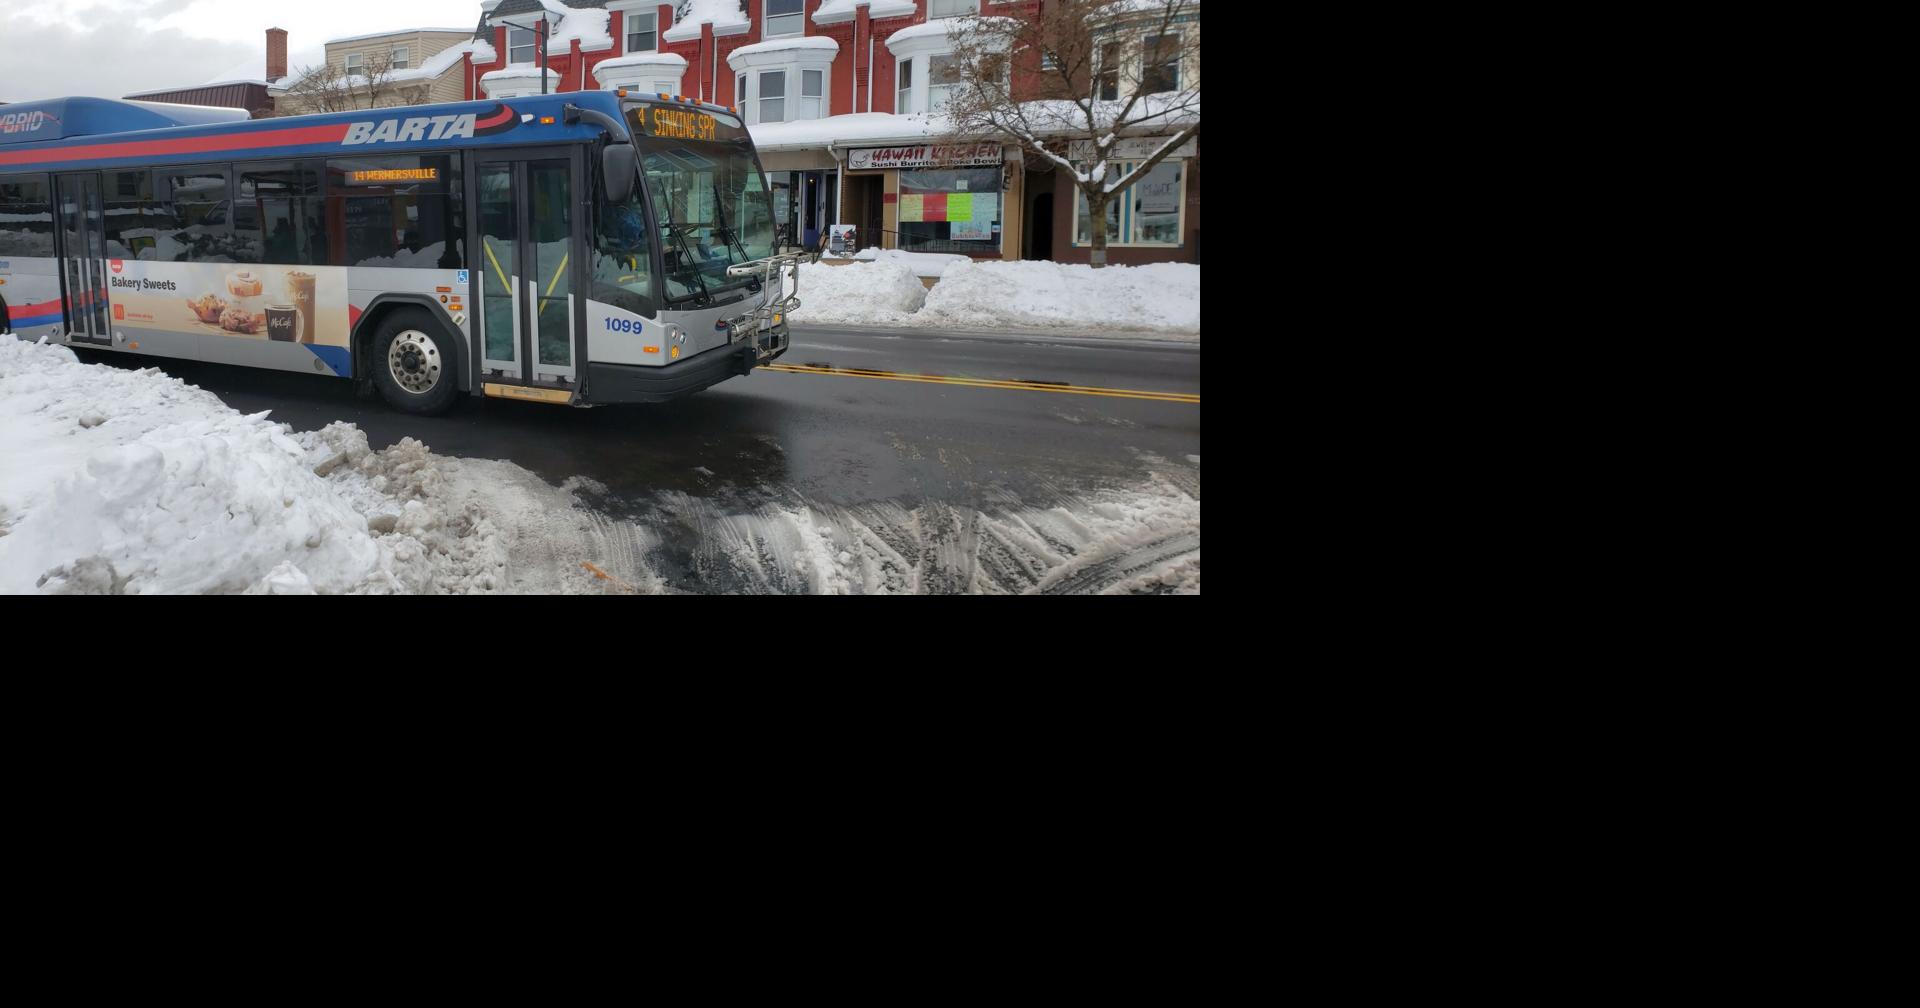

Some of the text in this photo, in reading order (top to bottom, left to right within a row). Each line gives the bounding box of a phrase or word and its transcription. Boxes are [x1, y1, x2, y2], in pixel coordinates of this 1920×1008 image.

[341, 113, 476, 146] BARTA
[654, 108, 695, 138] SINKING
[698, 114, 715, 141] SPR
[872, 147, 925, 161] HAWAII
[354, 168, 437, 181] 14 WERNERSVILLE
[112, 276, 176, 291] Bakery Sweets
[605, 316, 642, 334] 1099
